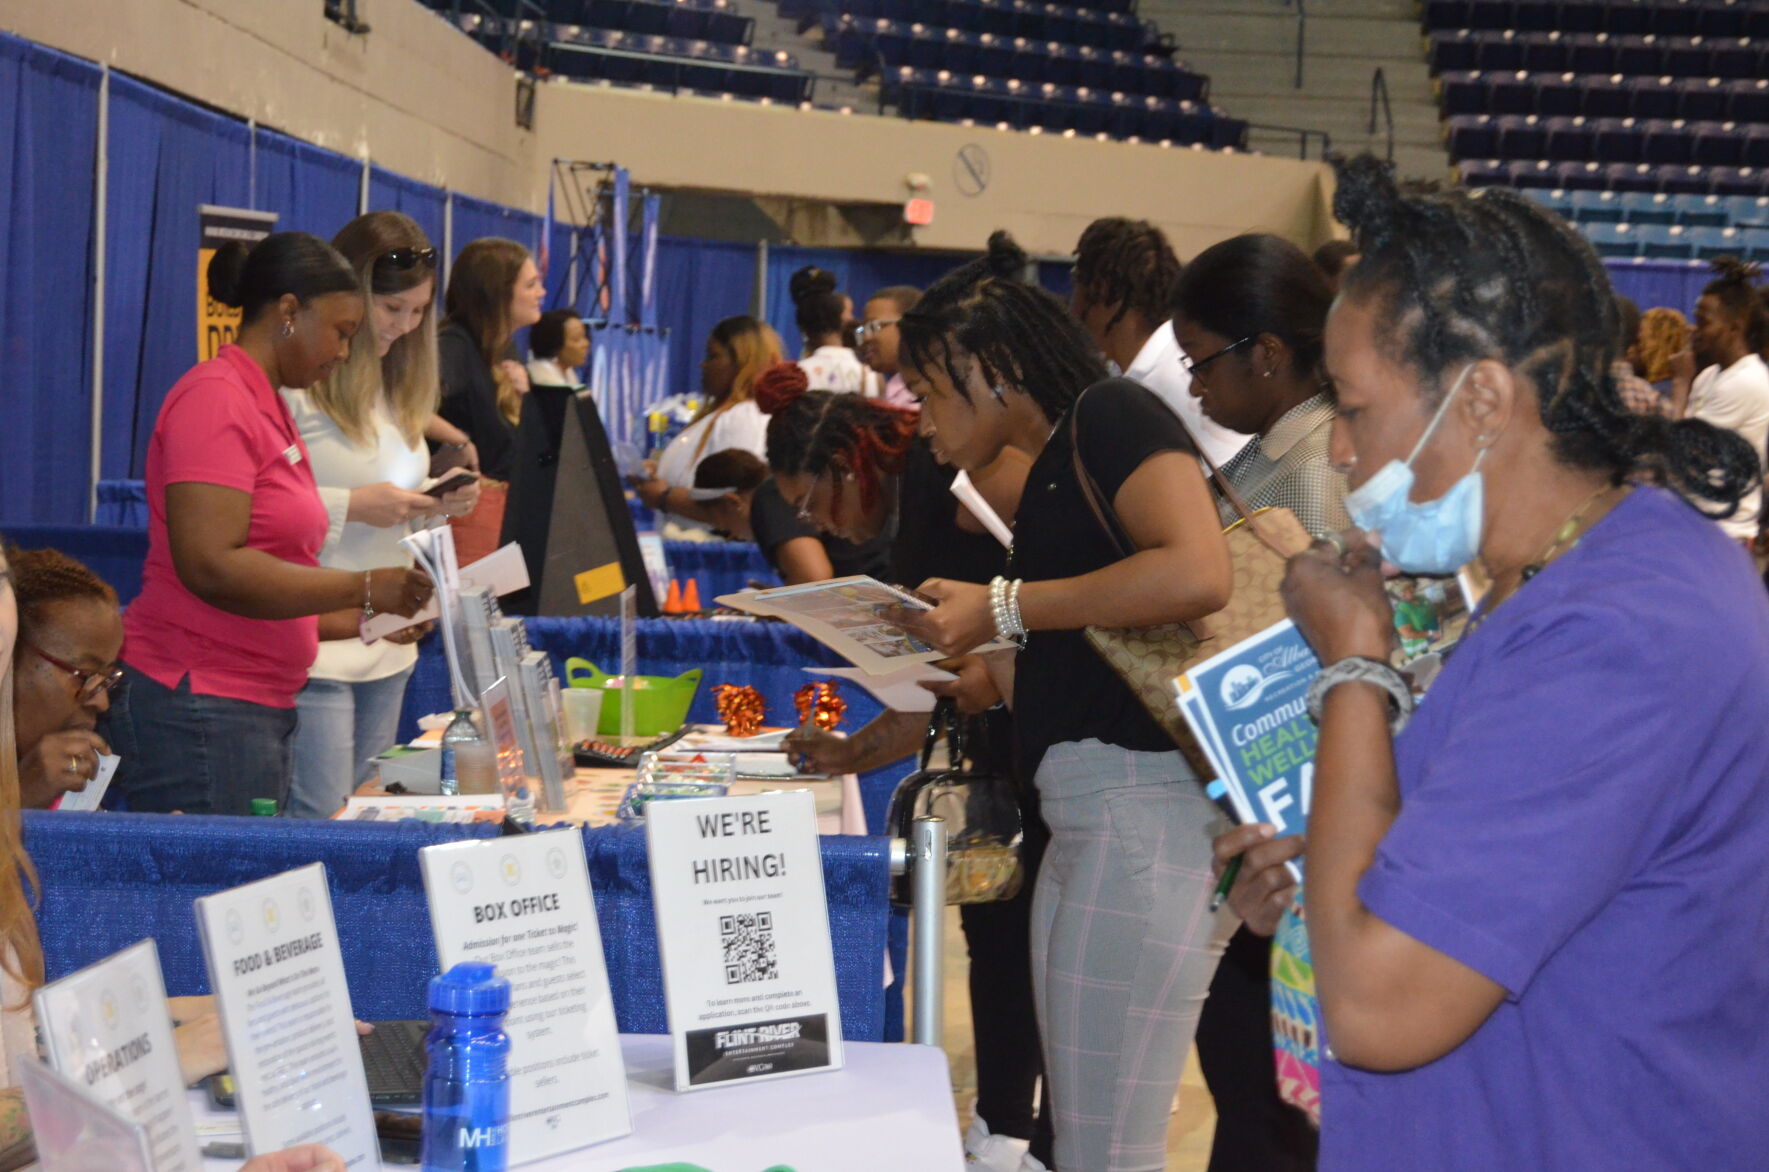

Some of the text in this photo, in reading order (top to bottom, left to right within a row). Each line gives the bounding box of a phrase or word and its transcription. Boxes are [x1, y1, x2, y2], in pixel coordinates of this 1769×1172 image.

[1232, 696, 1308, 746] Commu
[1240, 713, 1317, 768] HEAL
[1247, 734, 1317, 786] WELL
[697, 810, 772, 838] WE'RE
[692, 853, 786, 884] HIRING!
[473, 893, 560, 924] BOX OFFICE
[233, 932, 324, 976] FOOD & BEVERAGE
[463, 936, 499, 951] Admission
[501, 935, 511, 947] for
[707, 999, 716, 1007] To
[715, 1021, 803, 1050] FLINT RIVER
[723, 1045, 768, 1056] ENTERTAINMENT
[770, 1042, 794, 1050] COMPLEX
[85, 1032, 153, 1085] OPERATIONS
